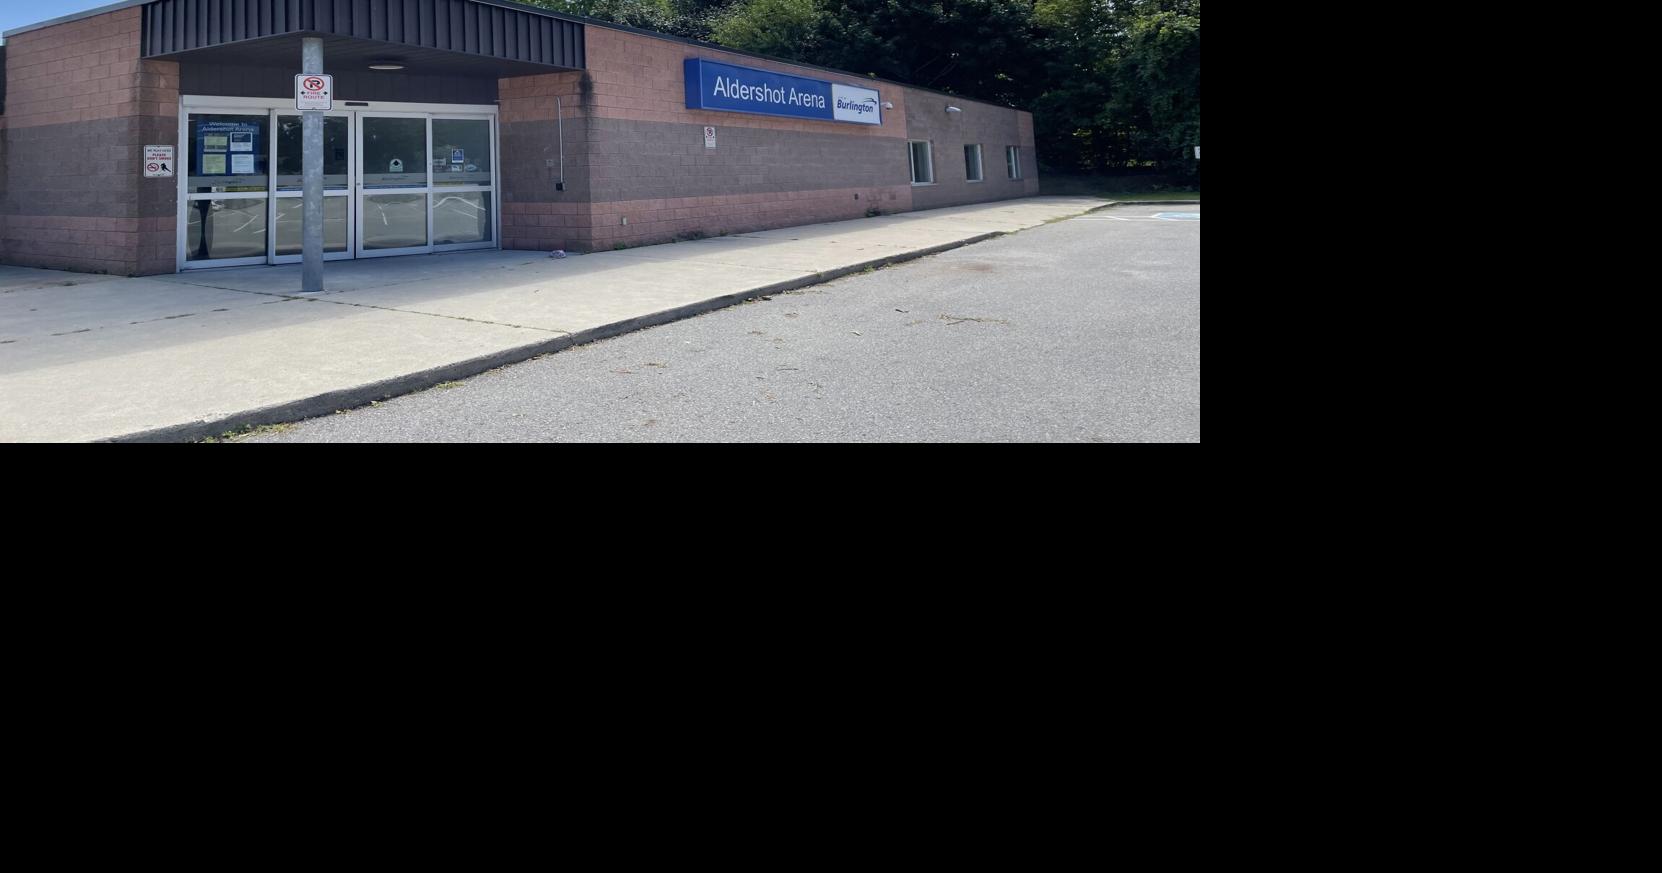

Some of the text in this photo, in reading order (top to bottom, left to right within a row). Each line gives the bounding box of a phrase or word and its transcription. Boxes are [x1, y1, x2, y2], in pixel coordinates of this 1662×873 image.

[713, 76, 825, 109] Aldershot Arena
[836, 99, 874, 114] Burlington
